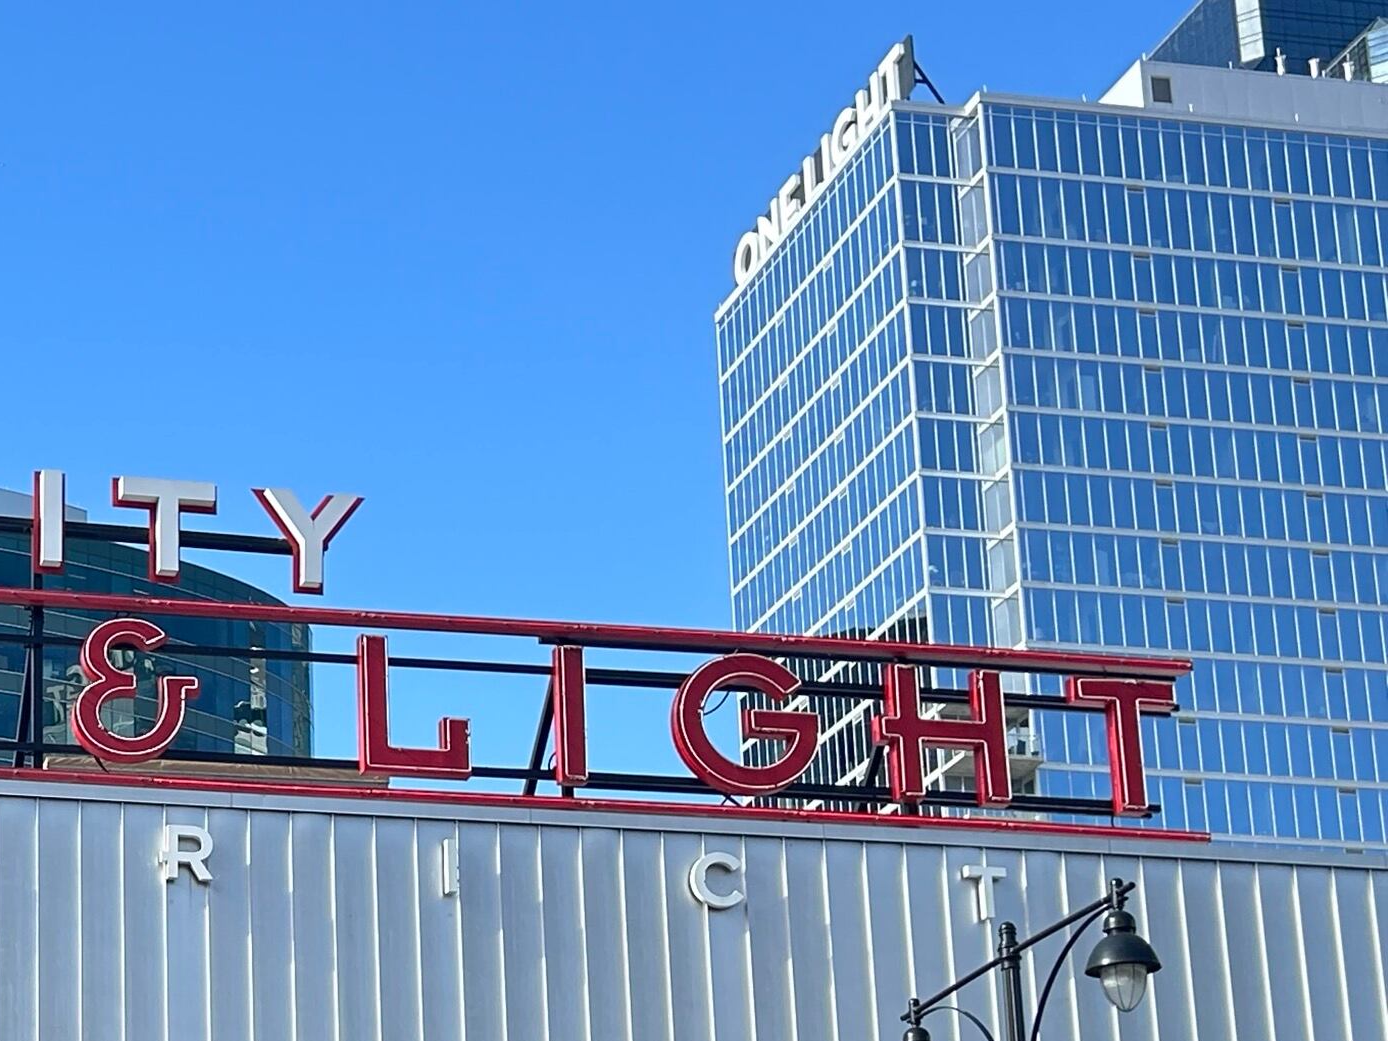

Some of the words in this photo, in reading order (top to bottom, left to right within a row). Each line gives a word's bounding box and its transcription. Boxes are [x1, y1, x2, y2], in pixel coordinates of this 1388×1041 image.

[733, 172, 803, 287] ONE
[802, 36, 912, 203] LIGHT
[71, 617, 199, 765] &
[357, 634, 1178, 818] LIGHT
